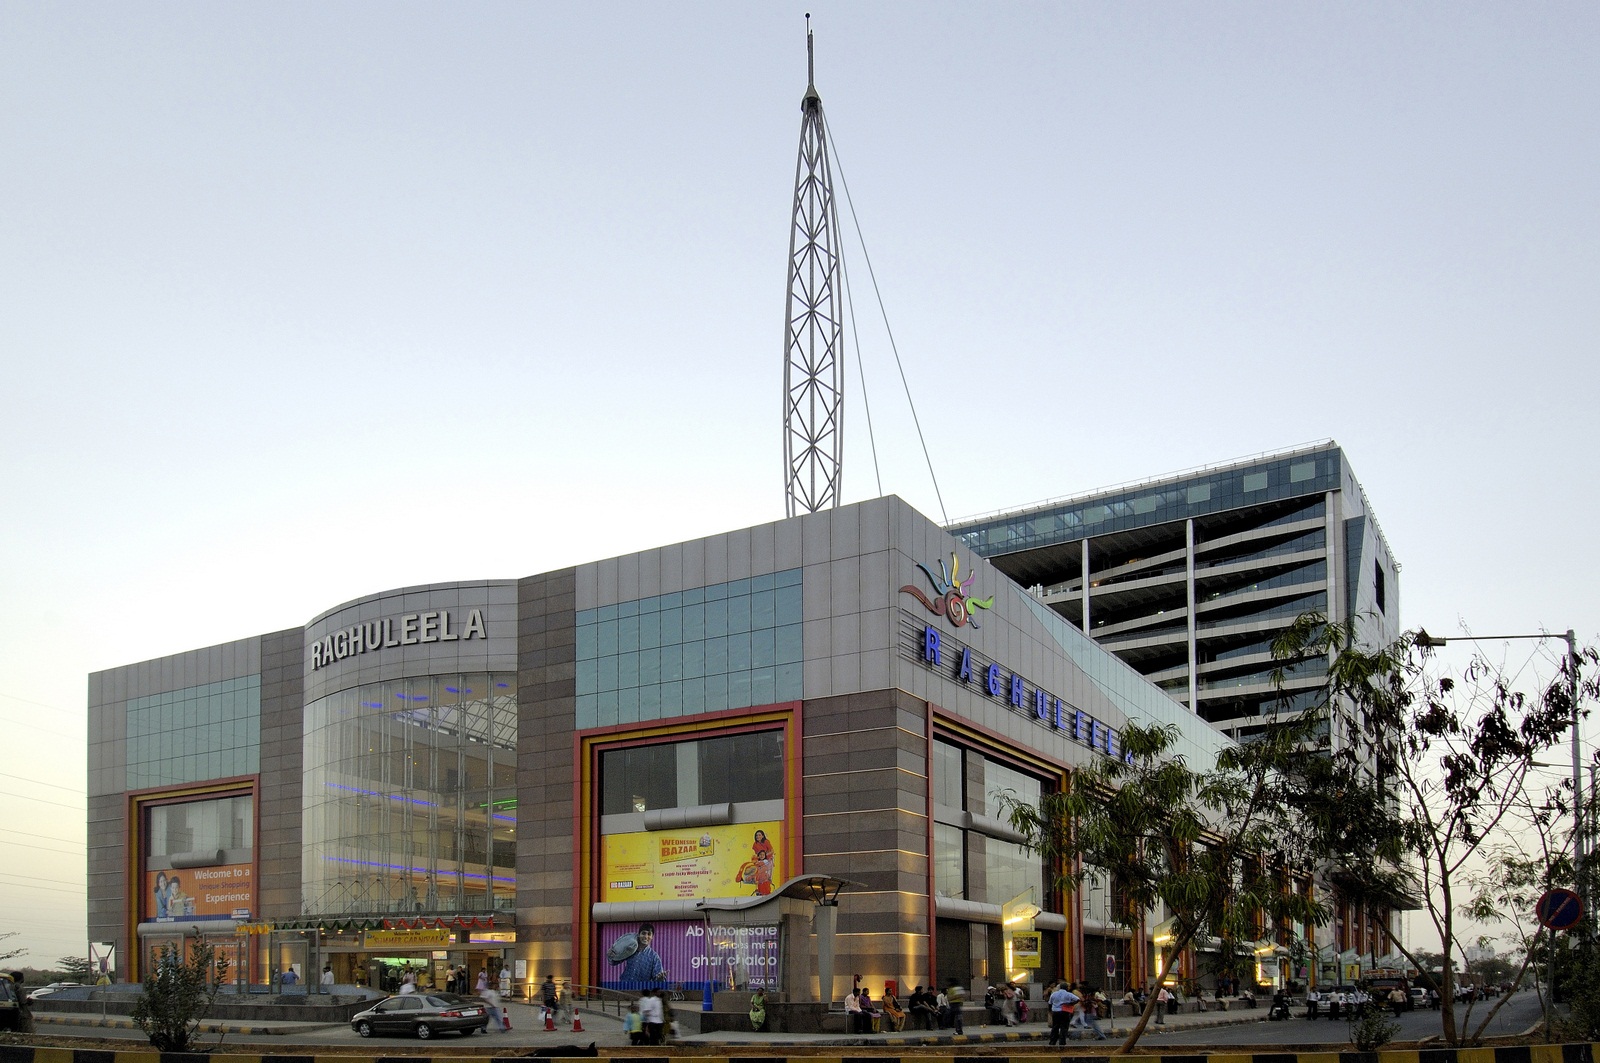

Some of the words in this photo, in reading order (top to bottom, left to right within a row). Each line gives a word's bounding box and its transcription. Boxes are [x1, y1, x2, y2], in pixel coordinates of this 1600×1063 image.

[311, 608, 486, 671] RAGHULEELA
[661, 845, 697, 857] BAZAAR
[194, 868, 232, 880] Welcome
[233, 868, 243, 878] to
[244, 868, 250, 876] a
[221, 881, 250, 890] Shopping
[205, 892, 250, 904] Experience
[685, 925, 704, 937] Ab
[751, 940, 777, 950] mein
[691, 954, 723, 969] ghar
